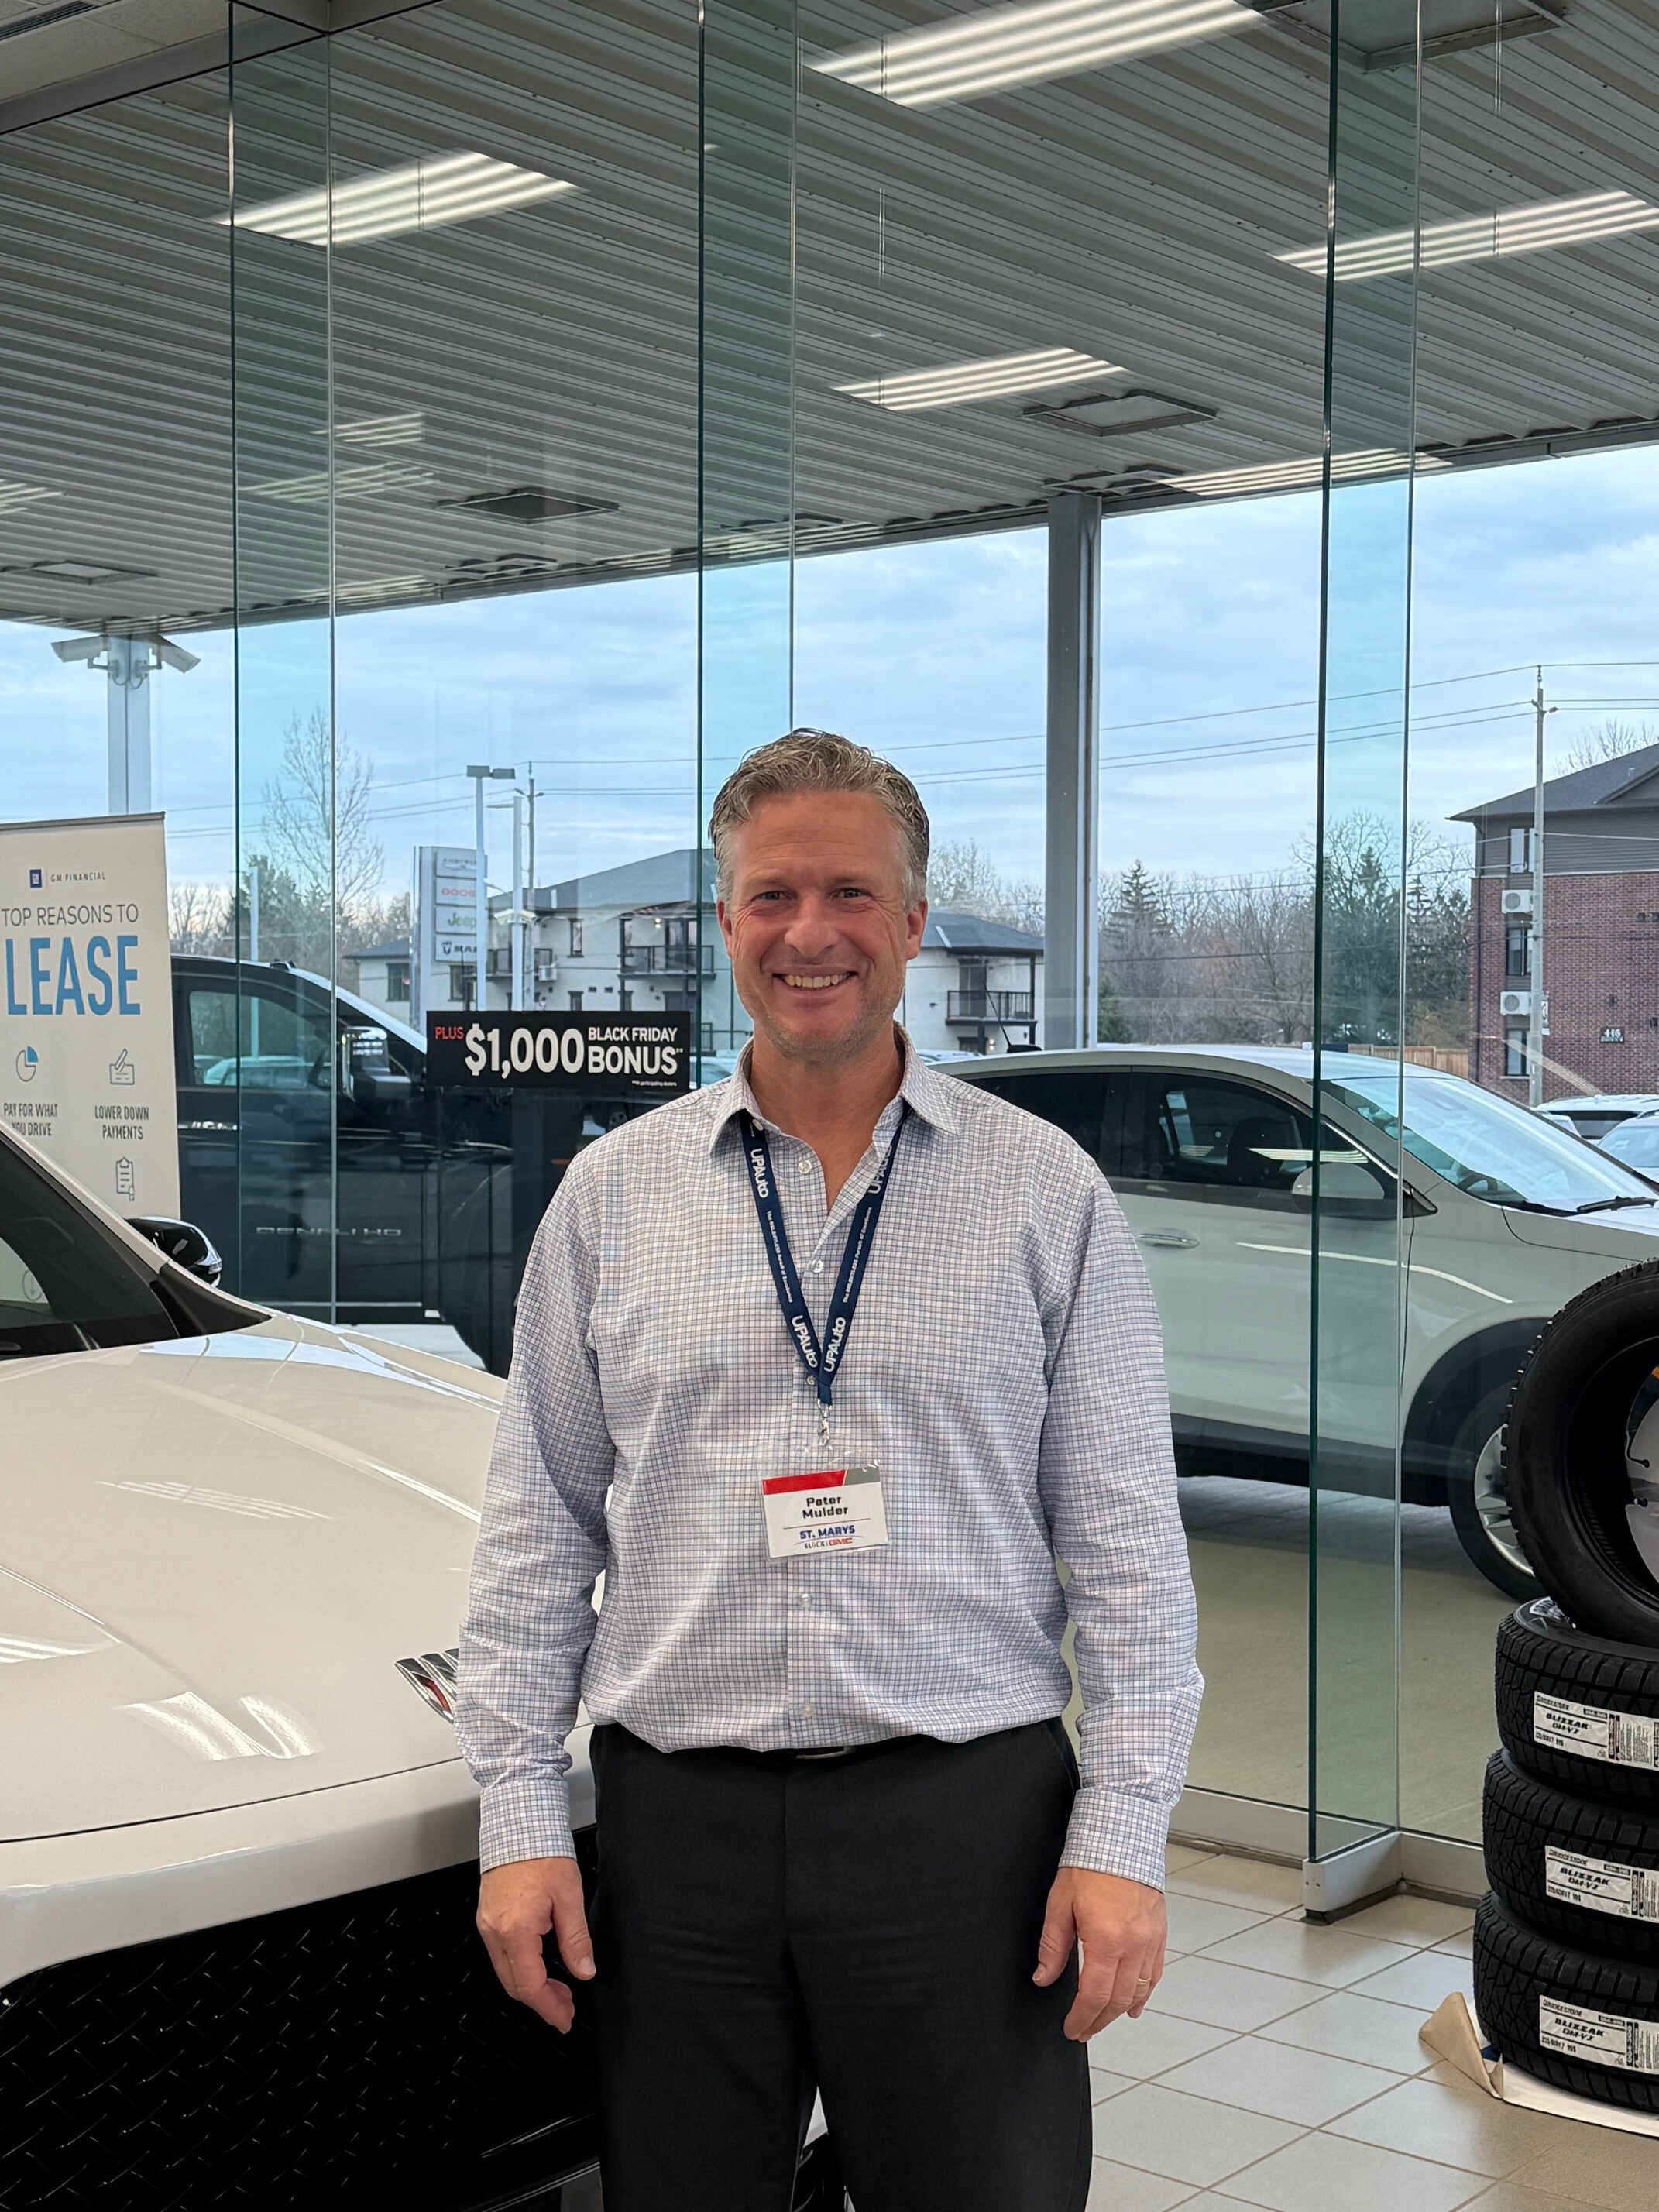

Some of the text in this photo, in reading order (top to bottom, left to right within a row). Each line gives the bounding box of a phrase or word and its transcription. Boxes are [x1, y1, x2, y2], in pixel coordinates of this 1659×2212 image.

[50, 874, 62, 882] GM
[65, 871, 105, 881] FINANCIAL
[2, 903, 139, 926] TOP REASONS TO
[6, 935, 140, 1015] LEASE
[588, 1027, 678, 1042] BLACK FRIDAY
[435, 1023, 584, 1078] PLUS $1,000
[4, 1103, 57, 1118] PAY FOR WHAT
[94, 1105, 149, 1121] LOWER DOWN
[28, 1123, 52, 1136] DRIVE
[103, 1125, 143, 1139] PAYMENTS
[792, 1315, 817, 1368] UPAuto
[824, 1317, 846, 1372] UPAuto
[806, 1497, 841, 1507] Peter
[802, 1506, 848, 1519] Mulder
[800, 1525, 855, 1539] ST. MARYS
[1546, 1712, 1589, 1729] BLIZZAK
[1561, 1867, 1610, 1885] BLIZZAK
[1555, 2018, 1606, 2036] BLIZZAK
